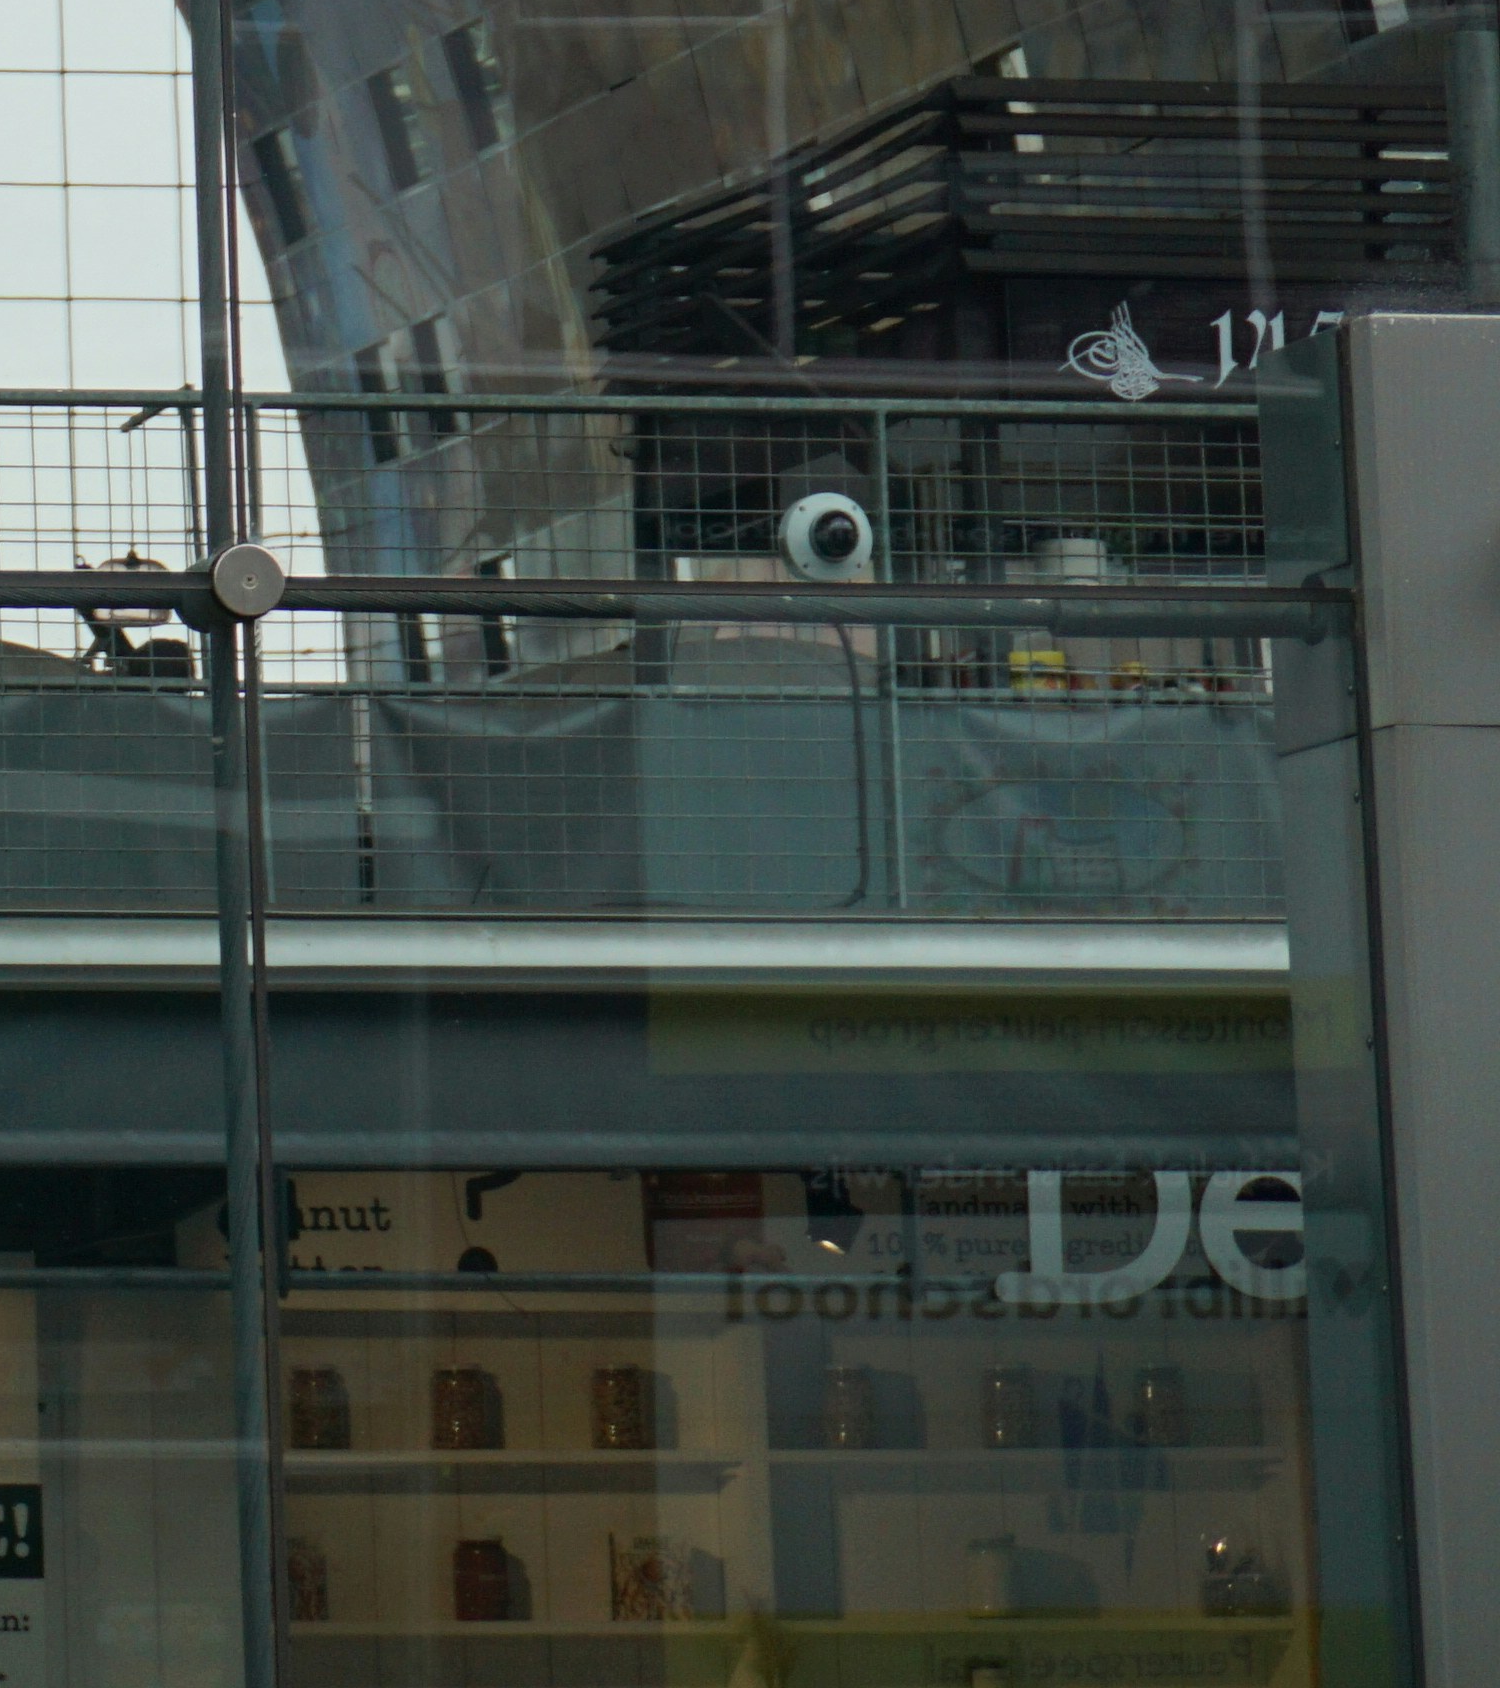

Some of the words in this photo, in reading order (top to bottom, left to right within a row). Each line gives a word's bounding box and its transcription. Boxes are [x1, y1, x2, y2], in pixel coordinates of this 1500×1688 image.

[299, 1197, 392, 1232] nut
[1068, 1194, 1141, 1216] with
[867, 1231, 950, 1257] 10%
[955, 1237, 1031, 1262] pure
